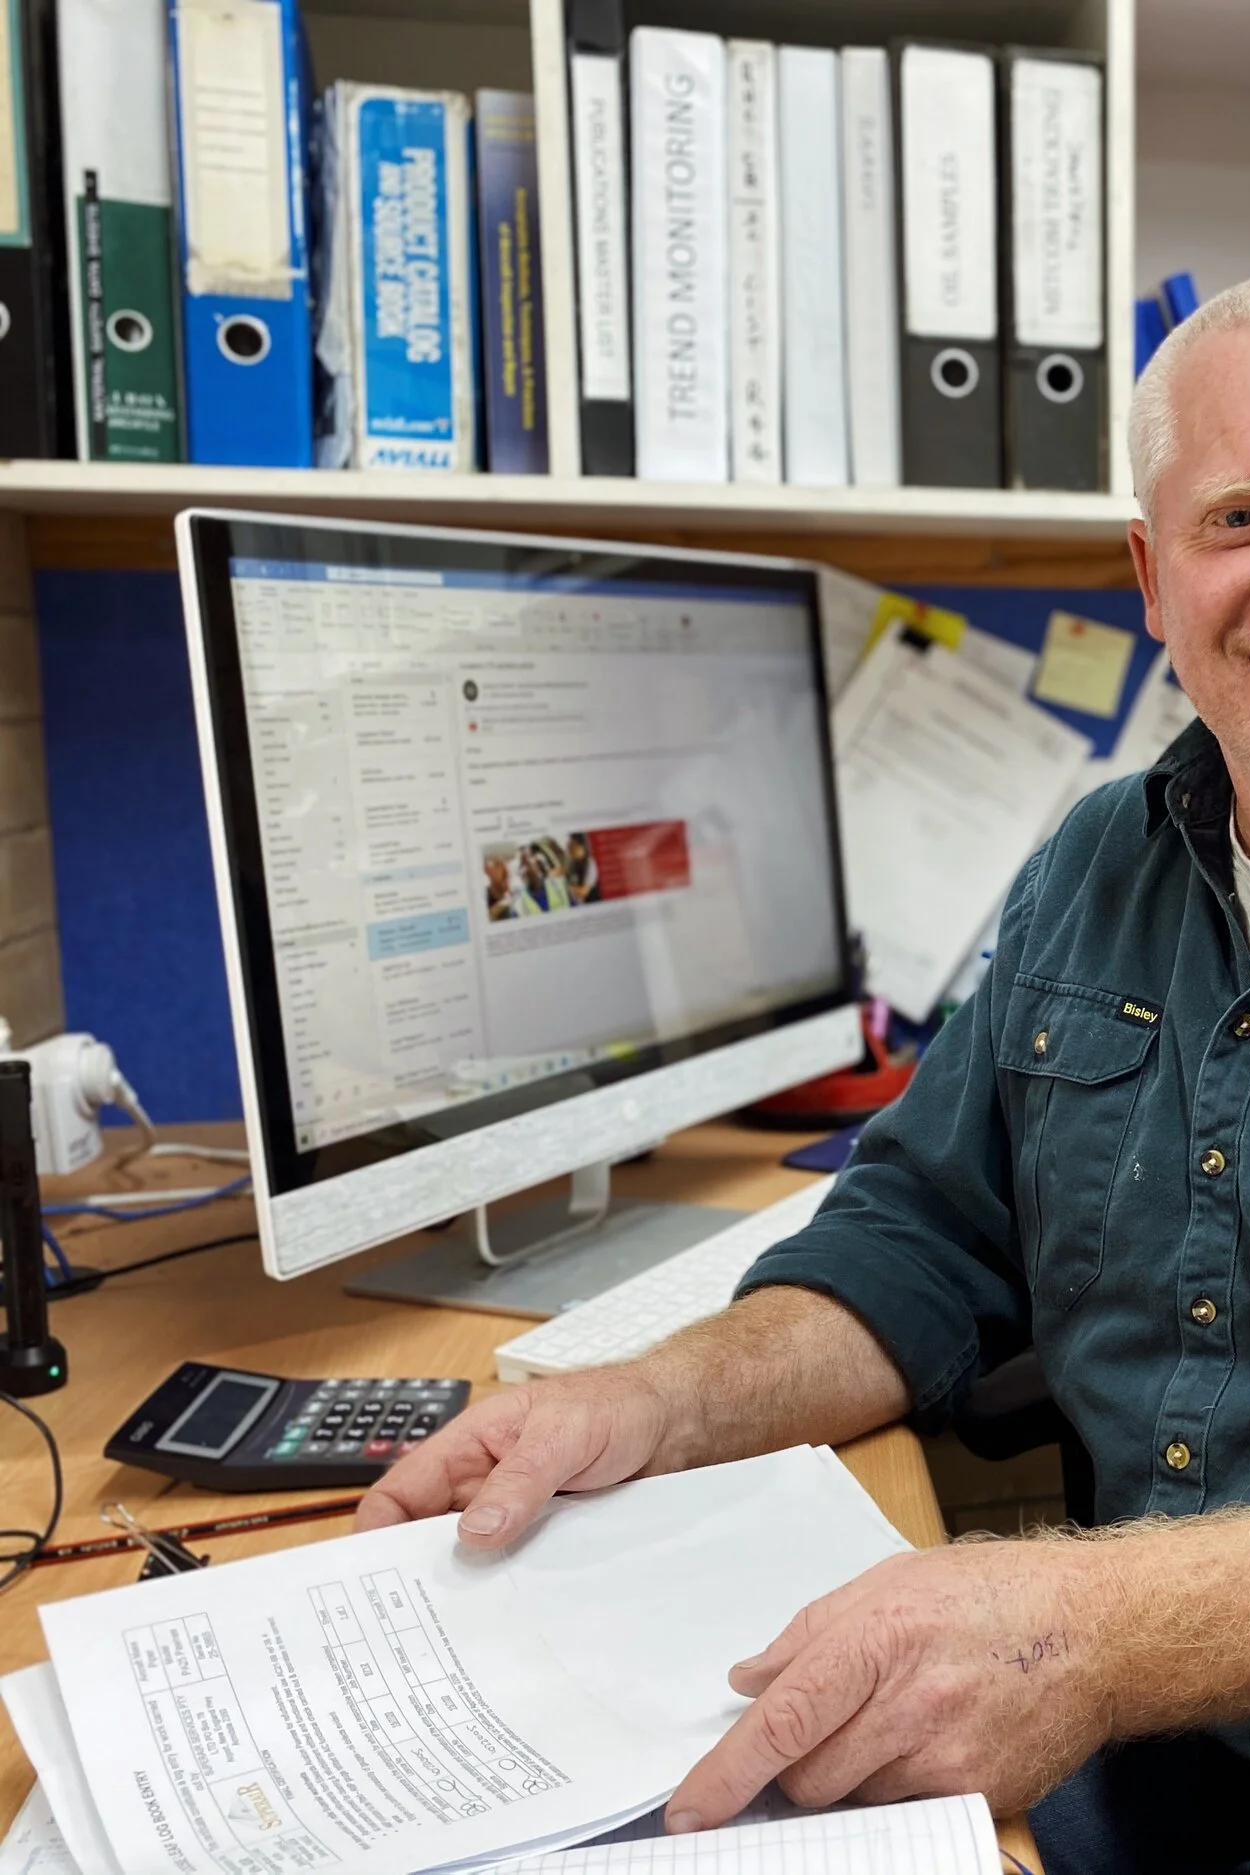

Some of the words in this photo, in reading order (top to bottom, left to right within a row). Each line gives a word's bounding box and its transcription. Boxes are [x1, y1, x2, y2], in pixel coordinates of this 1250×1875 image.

[378, 160, 403, 197] AND
[587, 96, 611, 236] PUBLICATIONS
[402, 148, 439, 258] PRODUCT
[664, 71, 699, 303] MONITORING
[938, 151, 961, 261] SAMPLES
[373, 196, 407, 278] SOURCE
[593, 238, 616, 317] MASTER
[940, 268, 962, 308] OIL
[376, 278, 407, 339] BOOK
[404, 260, 442, 364] CATALOG
[596, 319, 616, 359] LIST
[667, 311, 699, 422] TREND
[1122, 1002, 1159, 1023] Bisley
[146, 1699, 164, 1725] carried
[179, 1708, 202, 1744] SERVICES
[131, 1768, 155, 1799] ENTRY
[142, 1797, 167, 1824] BOOK
[154, 1822, 175, 1842] LOG
[163, 1841, 184, 1859] LEAF
